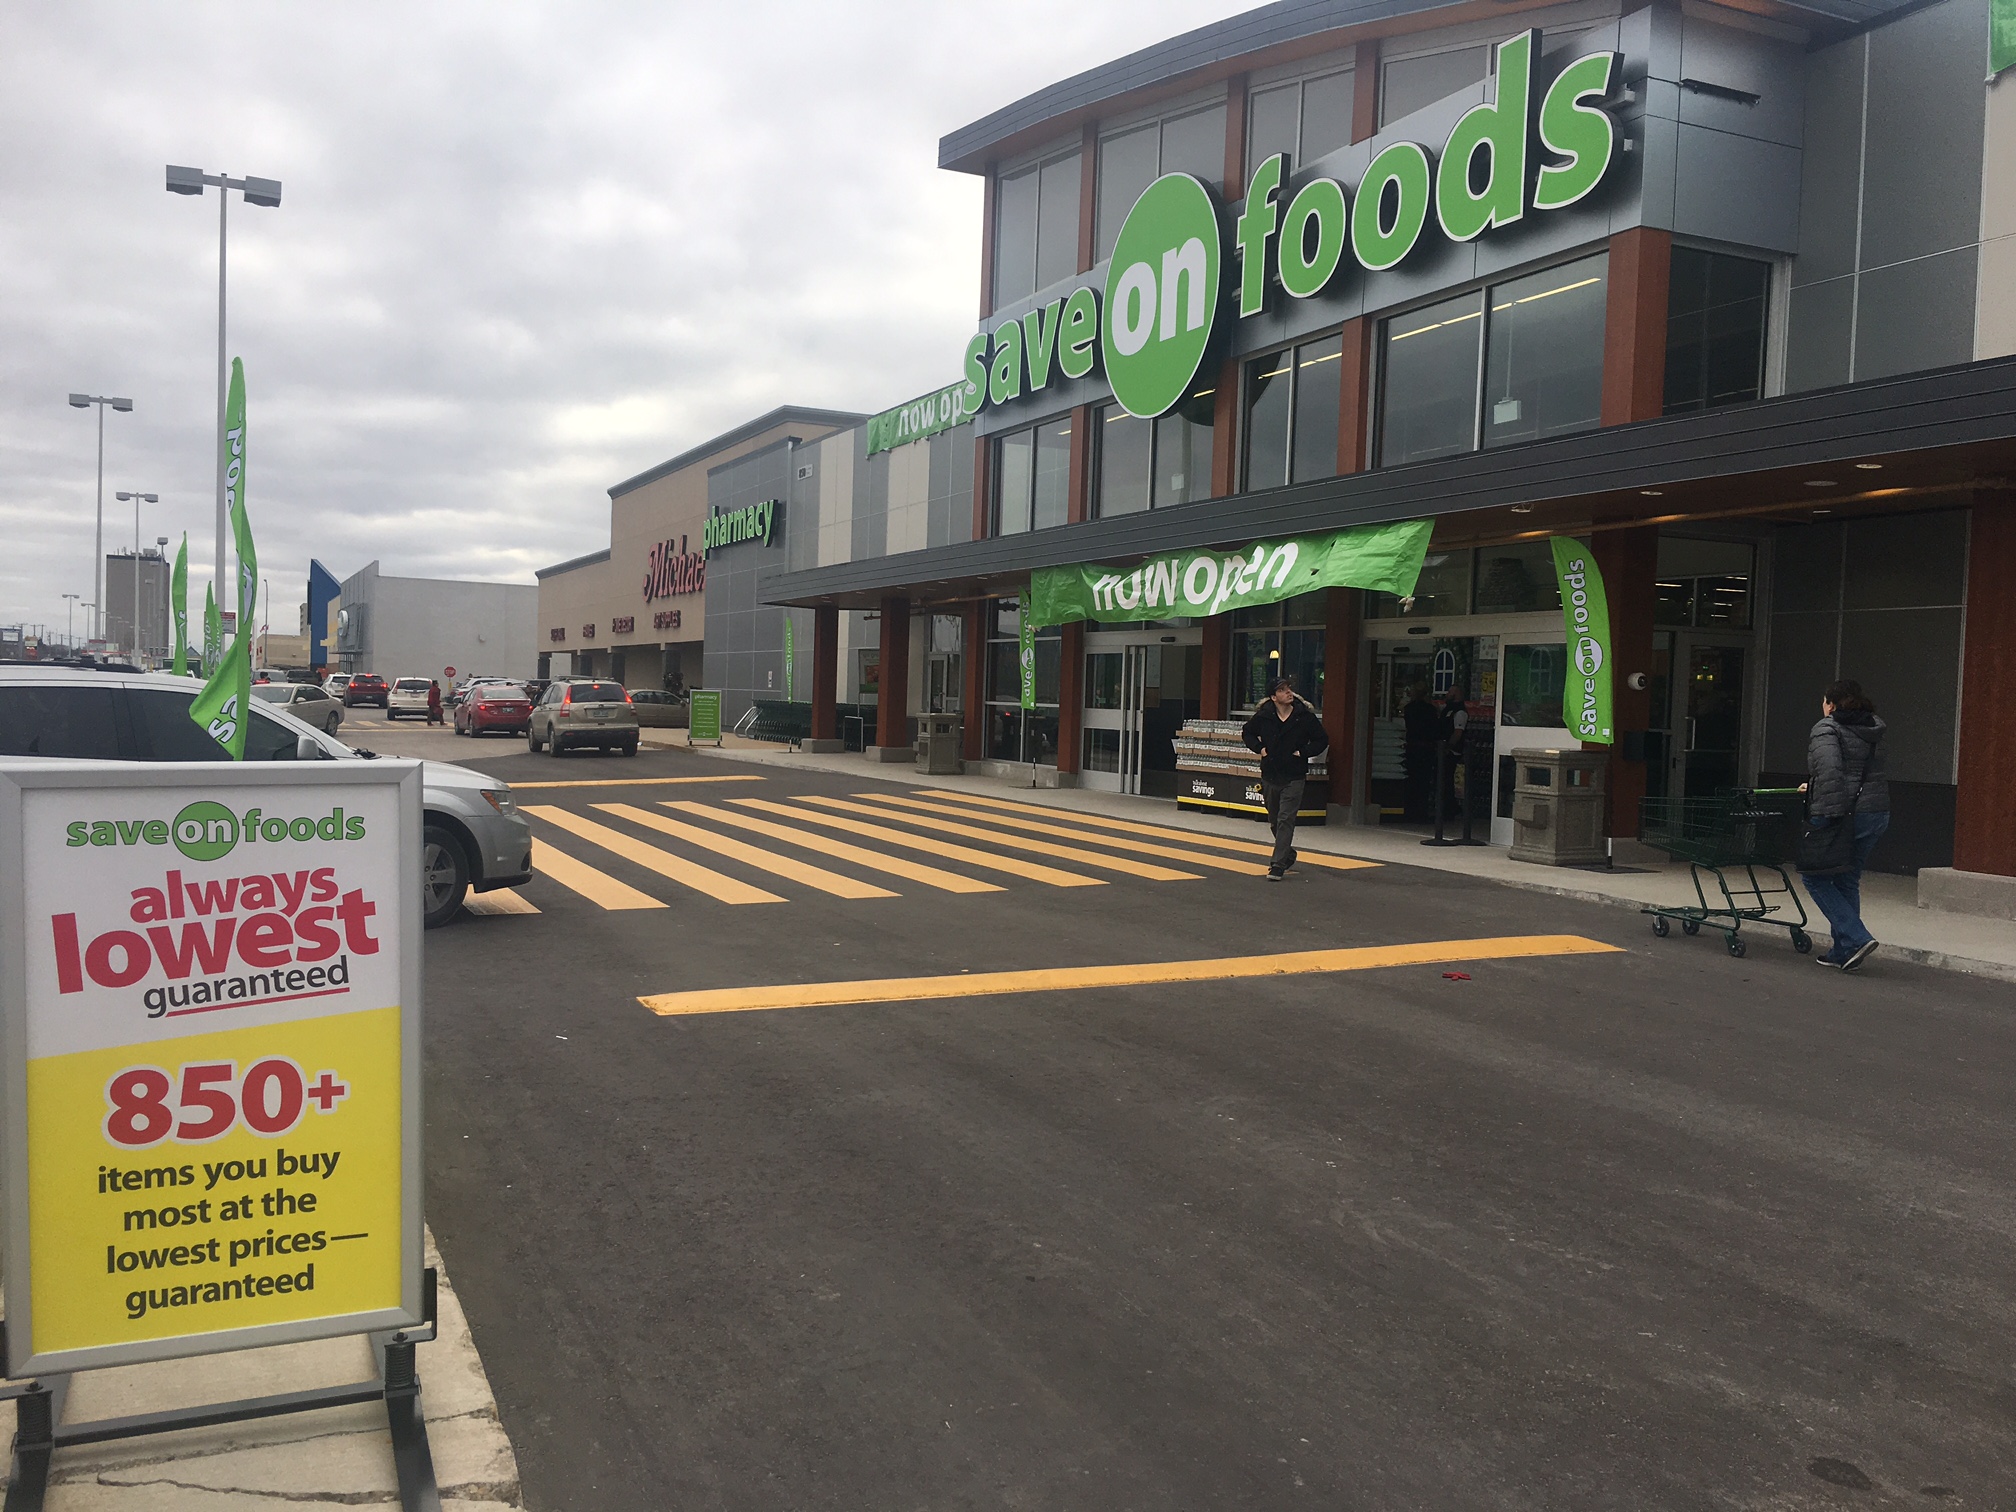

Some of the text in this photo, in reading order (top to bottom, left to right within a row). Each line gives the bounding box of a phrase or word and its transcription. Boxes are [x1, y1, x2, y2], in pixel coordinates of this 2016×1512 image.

[963, 28, 1621, 415] save on foods
[898, 387, 964, 437] now op
[703, 500, 775, 560] pharmacy
[642, 535, 706, 603] Michae
[1093, 542, 1299, 616] now open
[1564, 558, 1598, 736] save on foods
[1192, 785, 1215, 797] savings
[66, 807, 366, 848] save on foods
[130, 867, 339, 924] always
[51, 888, 380, 994] lowest
[143, 955, 350, 1019] guaranteed
[107, 1059, 345, 1145] 850+
[98, 1148, 341, 1194] items you buy
[124, 1188, 317, 1232] most at the
[107, 1238, 220, 1273] lowest
[125, 1263, 315, 1320] guaranteed
